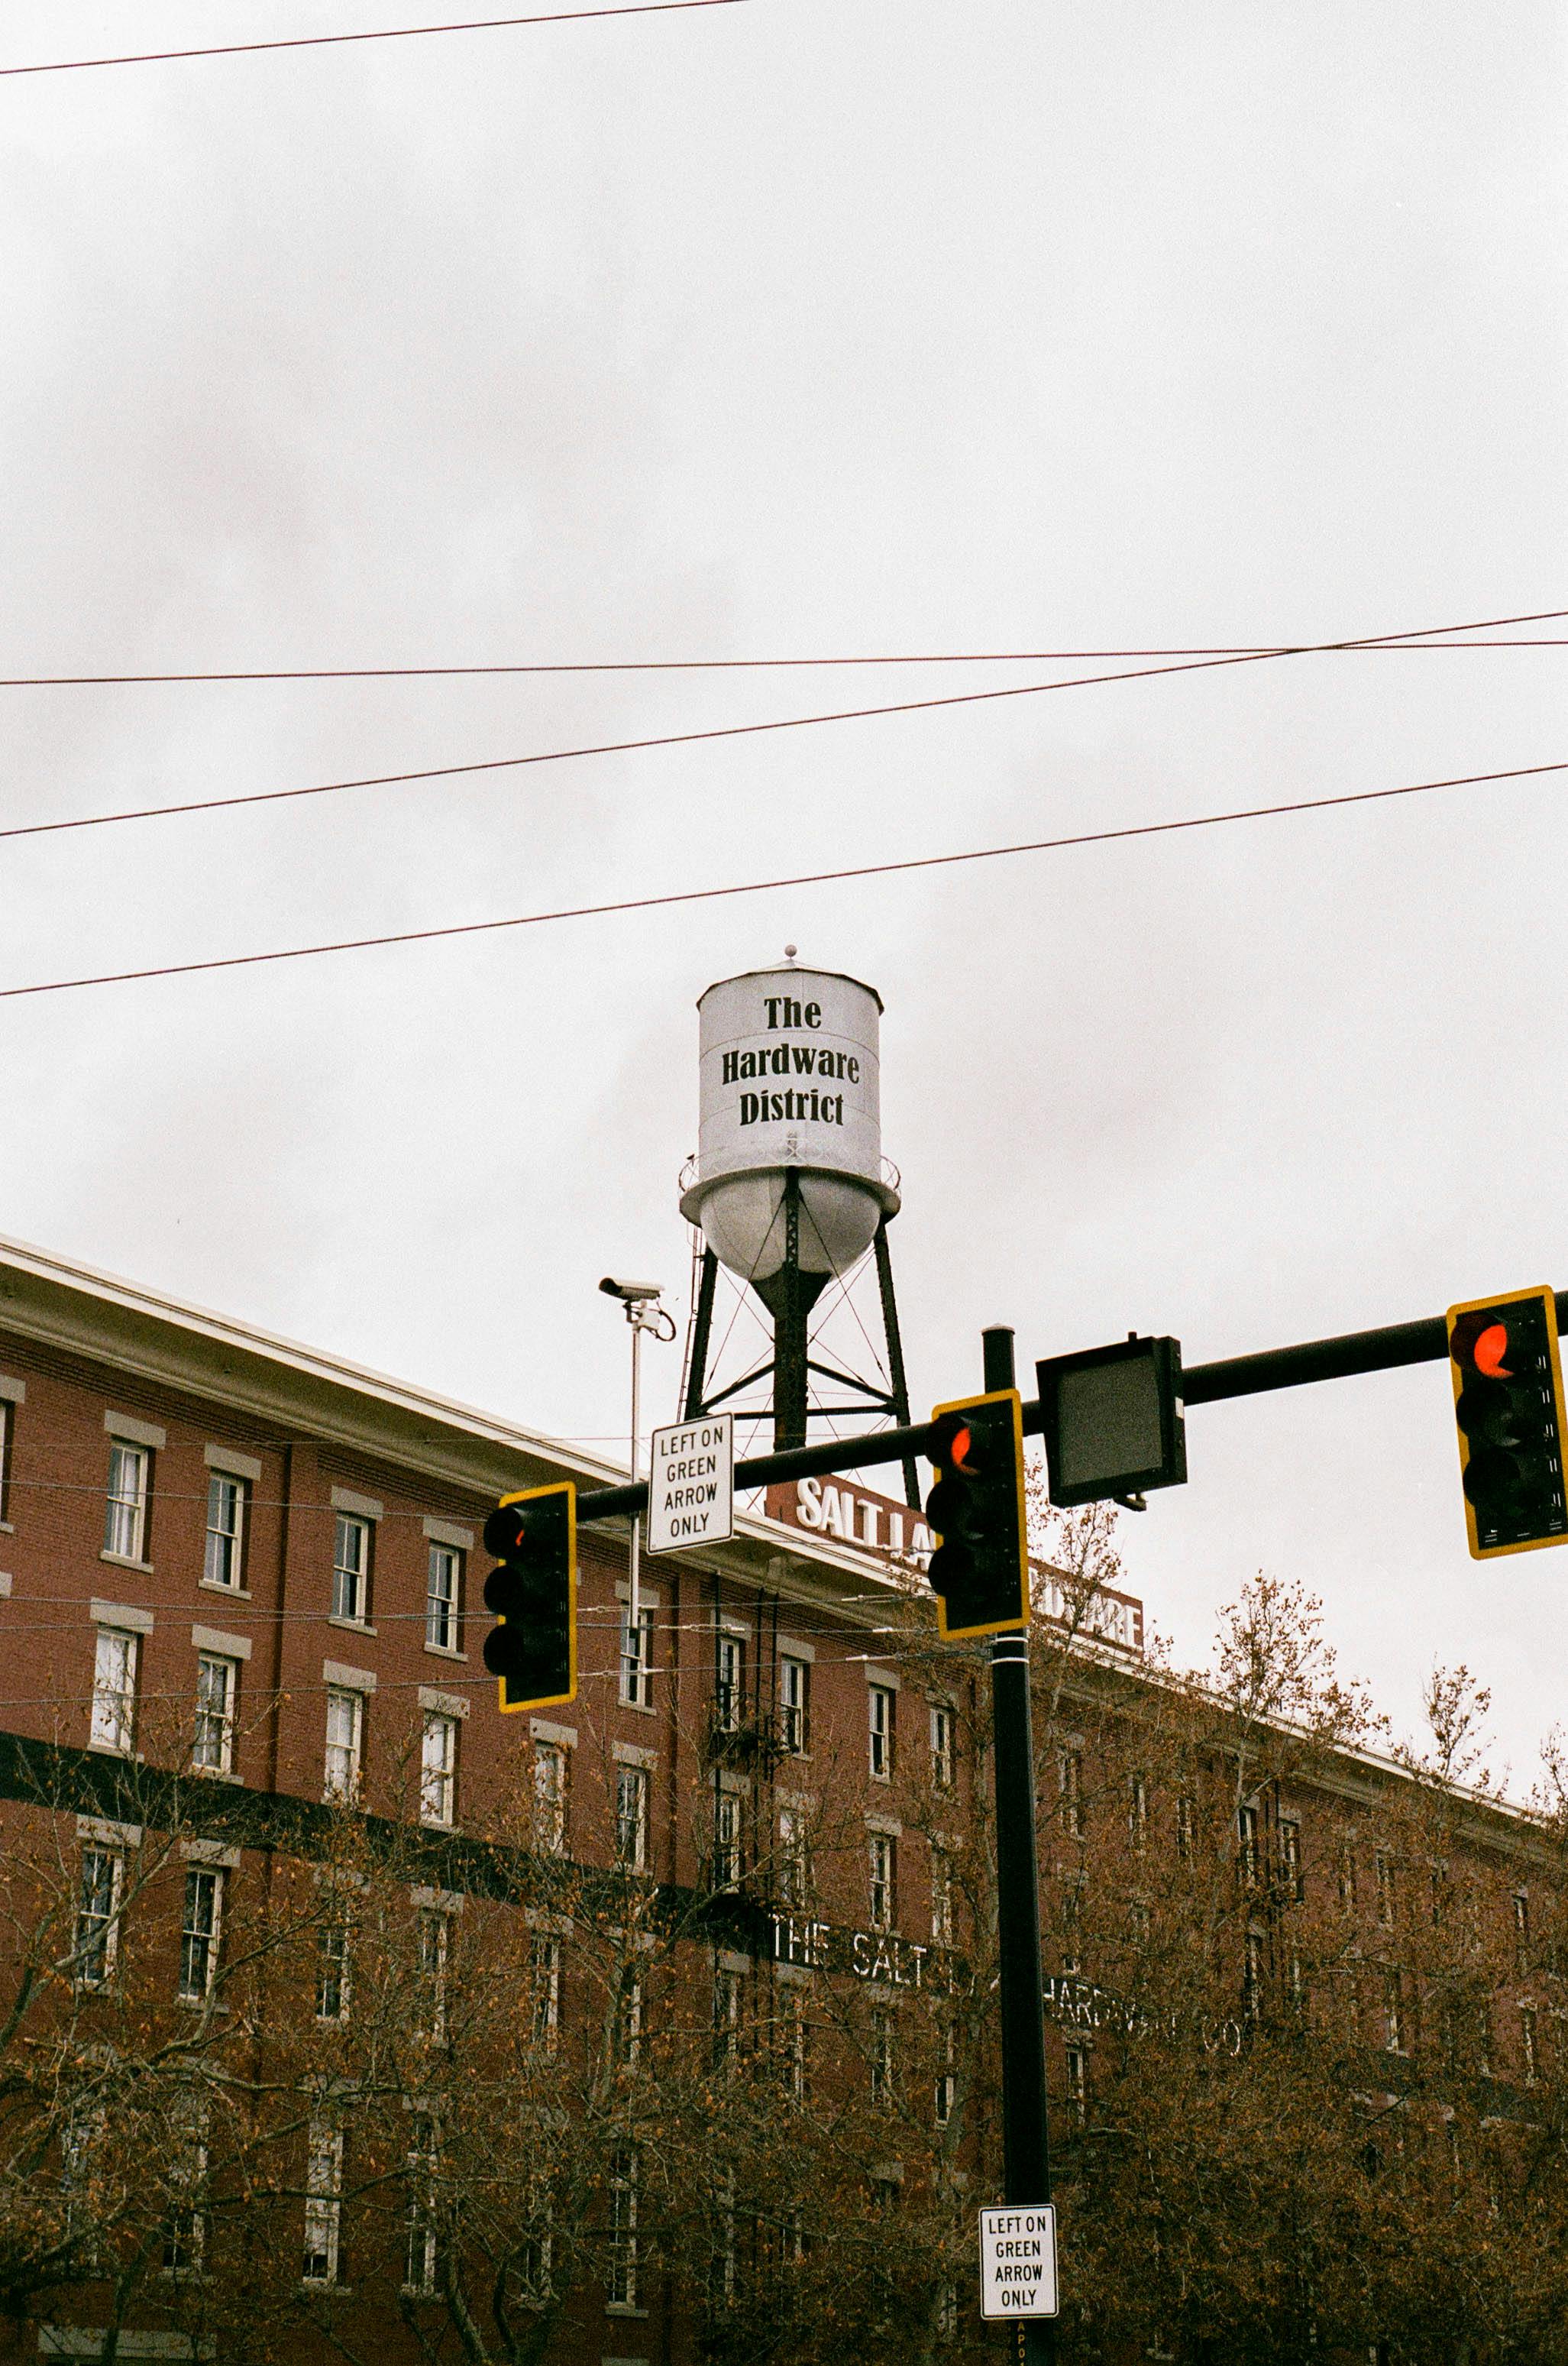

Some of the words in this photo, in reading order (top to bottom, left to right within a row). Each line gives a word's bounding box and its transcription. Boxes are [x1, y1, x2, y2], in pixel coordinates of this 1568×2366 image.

[764, 997, 821, 1029] The
[722, 1044, 860, 1085] Hardware
[739, 1088, 844, 1126] District
[661, 1432, 697, 1456] LEFT
[701, 1426, 723, 1447] ON
[667, 1455, 716, 1482] GREEN
[664, 1483, 717, 1511] ARROW
[671, 1513, 710, 1537] ONLY
[797, 1477, 883, 1548] SALT
[890, 1512, 936, 1573] LA
[768, 1913, 830, 1965] THE
[853, 1934, 926, 1986] SALT
[988, 2217, 1022, 2234] LEFT
[1026, 2216, 1046, 2232] ON
[996, 2241, 1041, 2258] GREEN
[995, 2265, 1043, 2282] ARROW
[1001, 2290, 1037, 2306] ONLY
